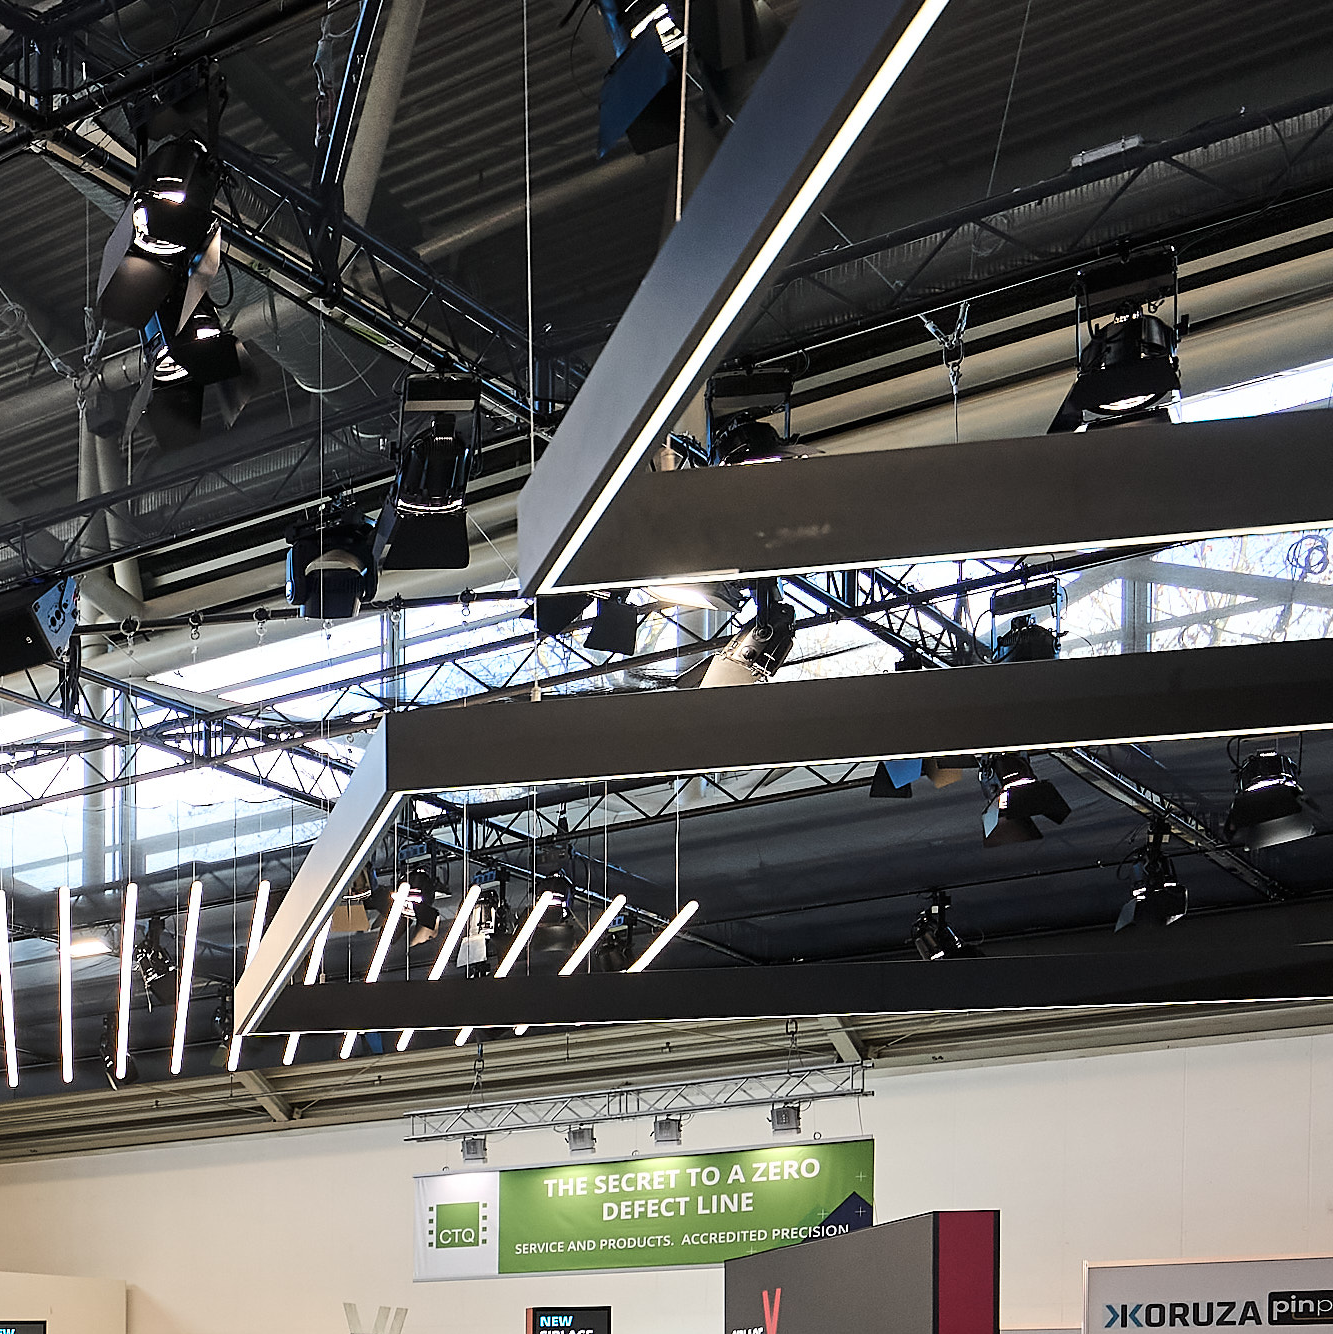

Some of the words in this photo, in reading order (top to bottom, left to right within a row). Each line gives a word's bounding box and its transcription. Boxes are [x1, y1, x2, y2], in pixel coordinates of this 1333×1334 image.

[543, 1178, 588, 1198] THE
[593, 1171, 676, 1195] SECRET
[689, 1167, 722, 1187] TO
[727, 1165, 746, 1184] A
[751, 1158, 821, 1183] ZERO
[602, 1196, 691, 1222] DEFECT
[697, 1192, 754, 1215] LINE
[439, 1228, 475, 1247] CTQ
[514, 1240, 567, 1255] SERVICE
[568, 1239, 597, 1252] AND
[599, 1234, 675, 1251] PRODUCTS.
[680, 1227, 768, 1246] ACCREDITED
[771, 1223, 850, 1241] PRECISION
[539, 1315, 574, 1327] NEW
